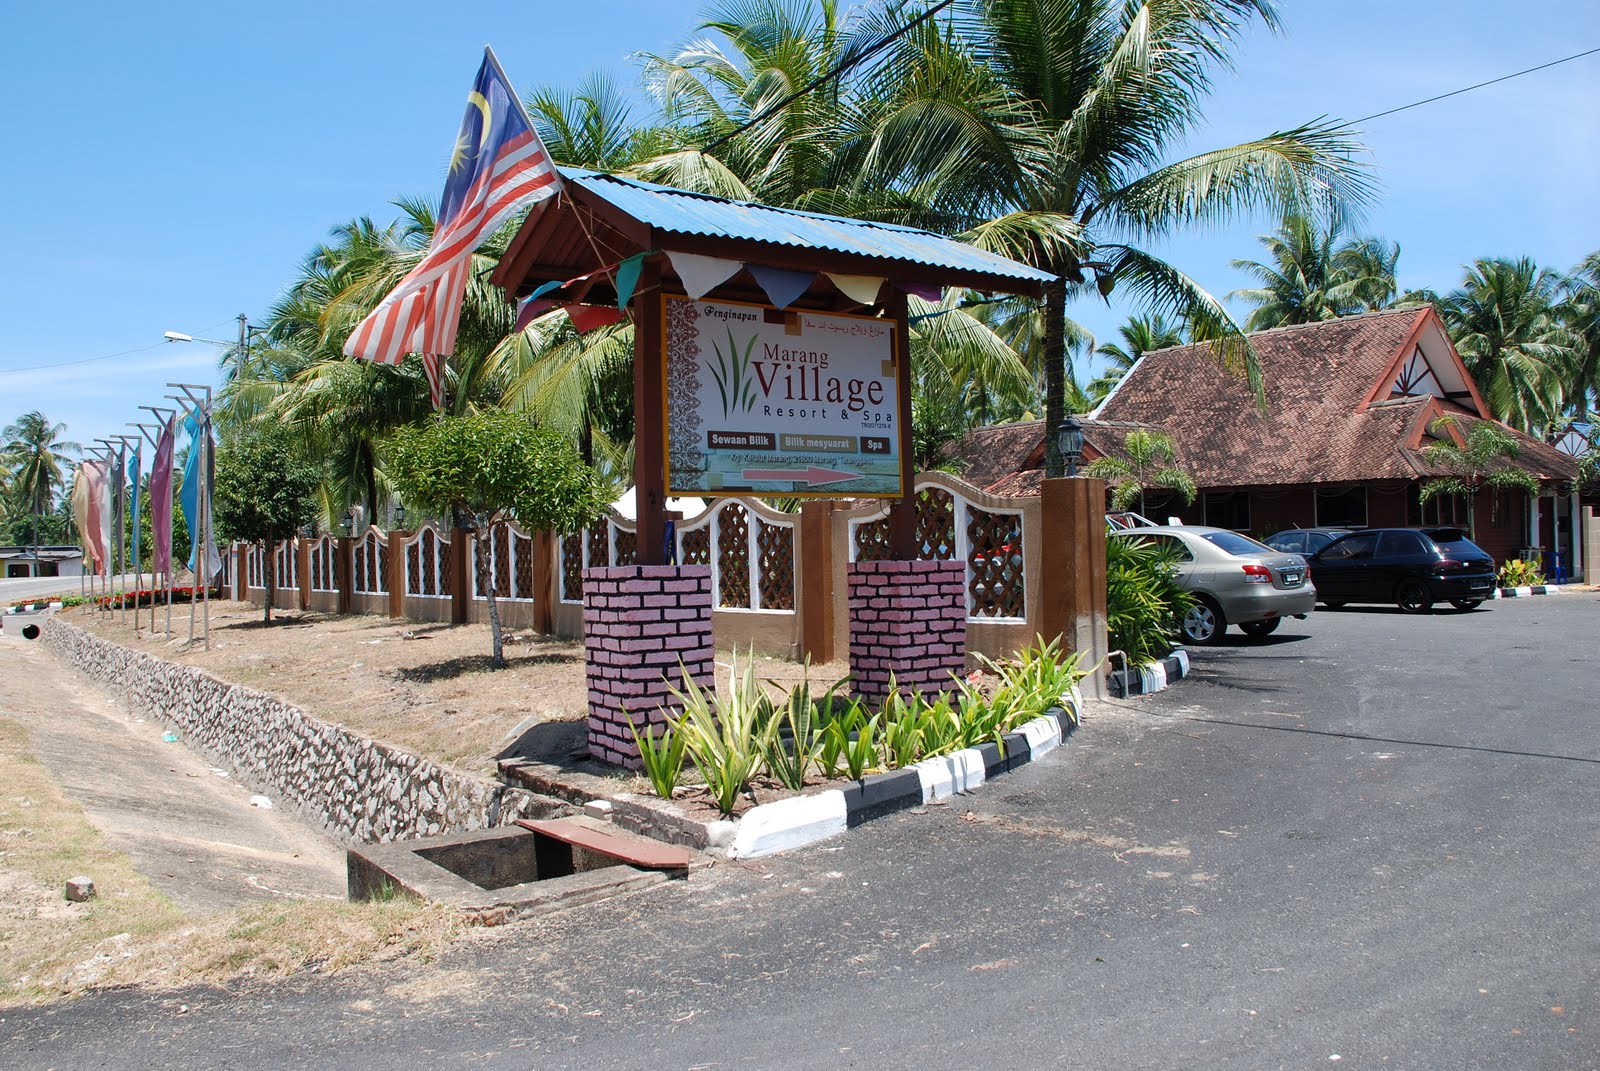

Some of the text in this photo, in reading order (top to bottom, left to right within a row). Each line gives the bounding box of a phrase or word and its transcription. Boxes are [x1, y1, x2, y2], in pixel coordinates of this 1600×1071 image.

[704, 305, 758, 322] Penginapan
[763, 343, 829, 369] Marang
[751, 361, 884, 412] Village
[764, 405, 892, 423] Resort & Spa
[712, 434, 769, 446] Sewaan Bilik
[785, 436, 850, 449] Bilik mesyuarat
[867, 440, 883, 450] Spa
